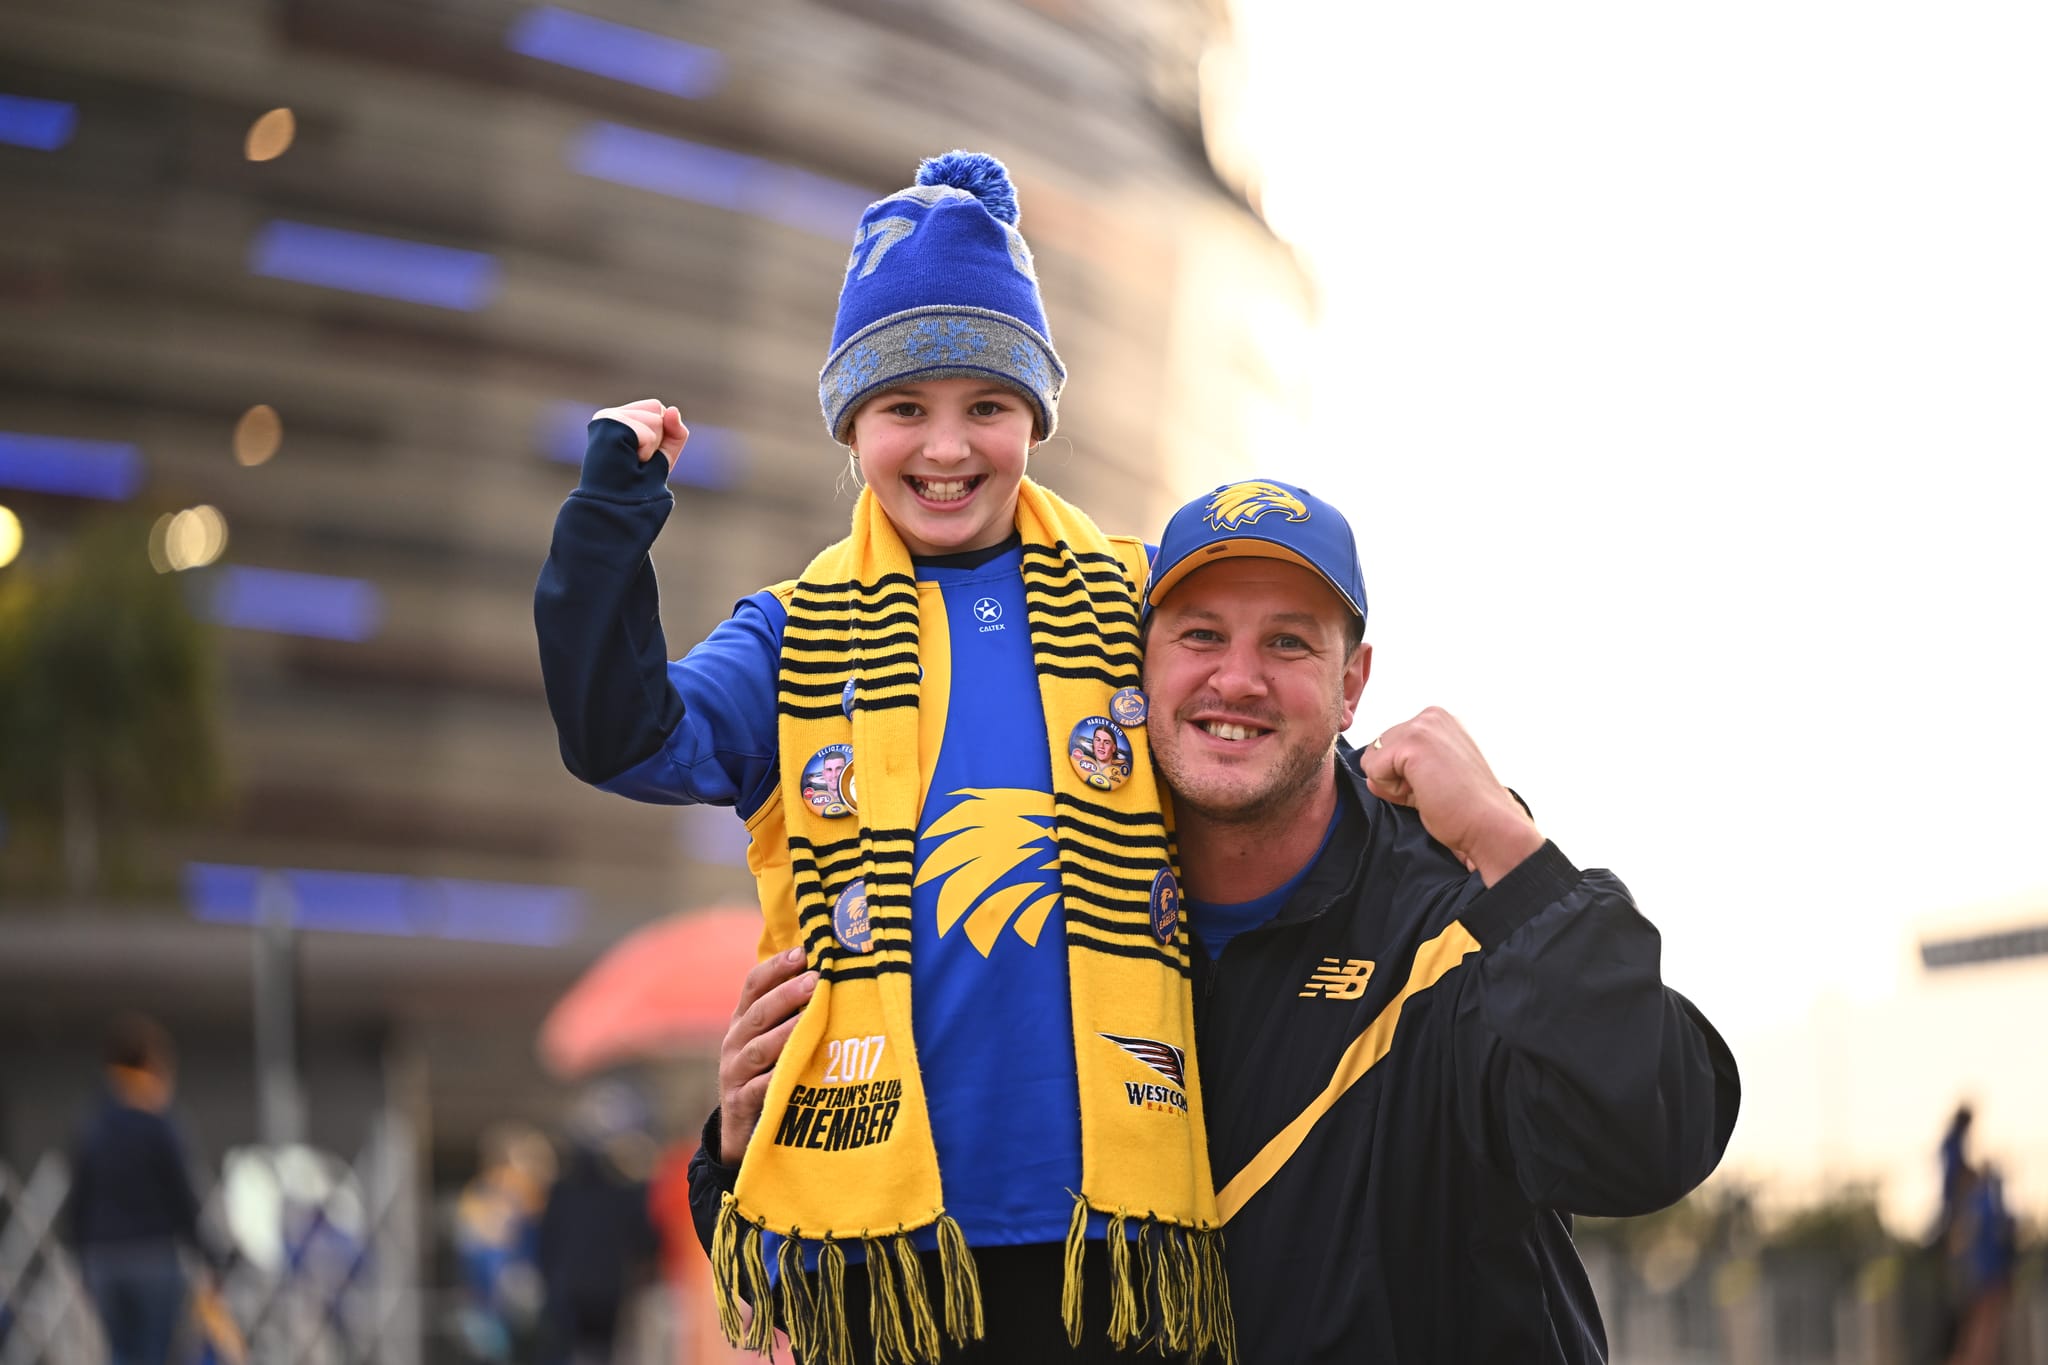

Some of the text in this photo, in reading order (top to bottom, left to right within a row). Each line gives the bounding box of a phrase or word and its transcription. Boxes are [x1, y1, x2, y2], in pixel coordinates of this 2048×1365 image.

[979, 624, 1006, 633] CALTEX
[1086, 718, 1123, 737] HARLEY REID
[817, 745, 840, 758] ELLIOT
[1080, 761, 1097, 772] AFL
[812, 796, 830, 805] AFL
[845, 920, 871, 939] EAGL
[822, 1035, 886, 1084] 2017
[788, 1078, 903, 1109] CAPTAIN'S CLUB
[774, 1100, 901, 1152] MEMBER
